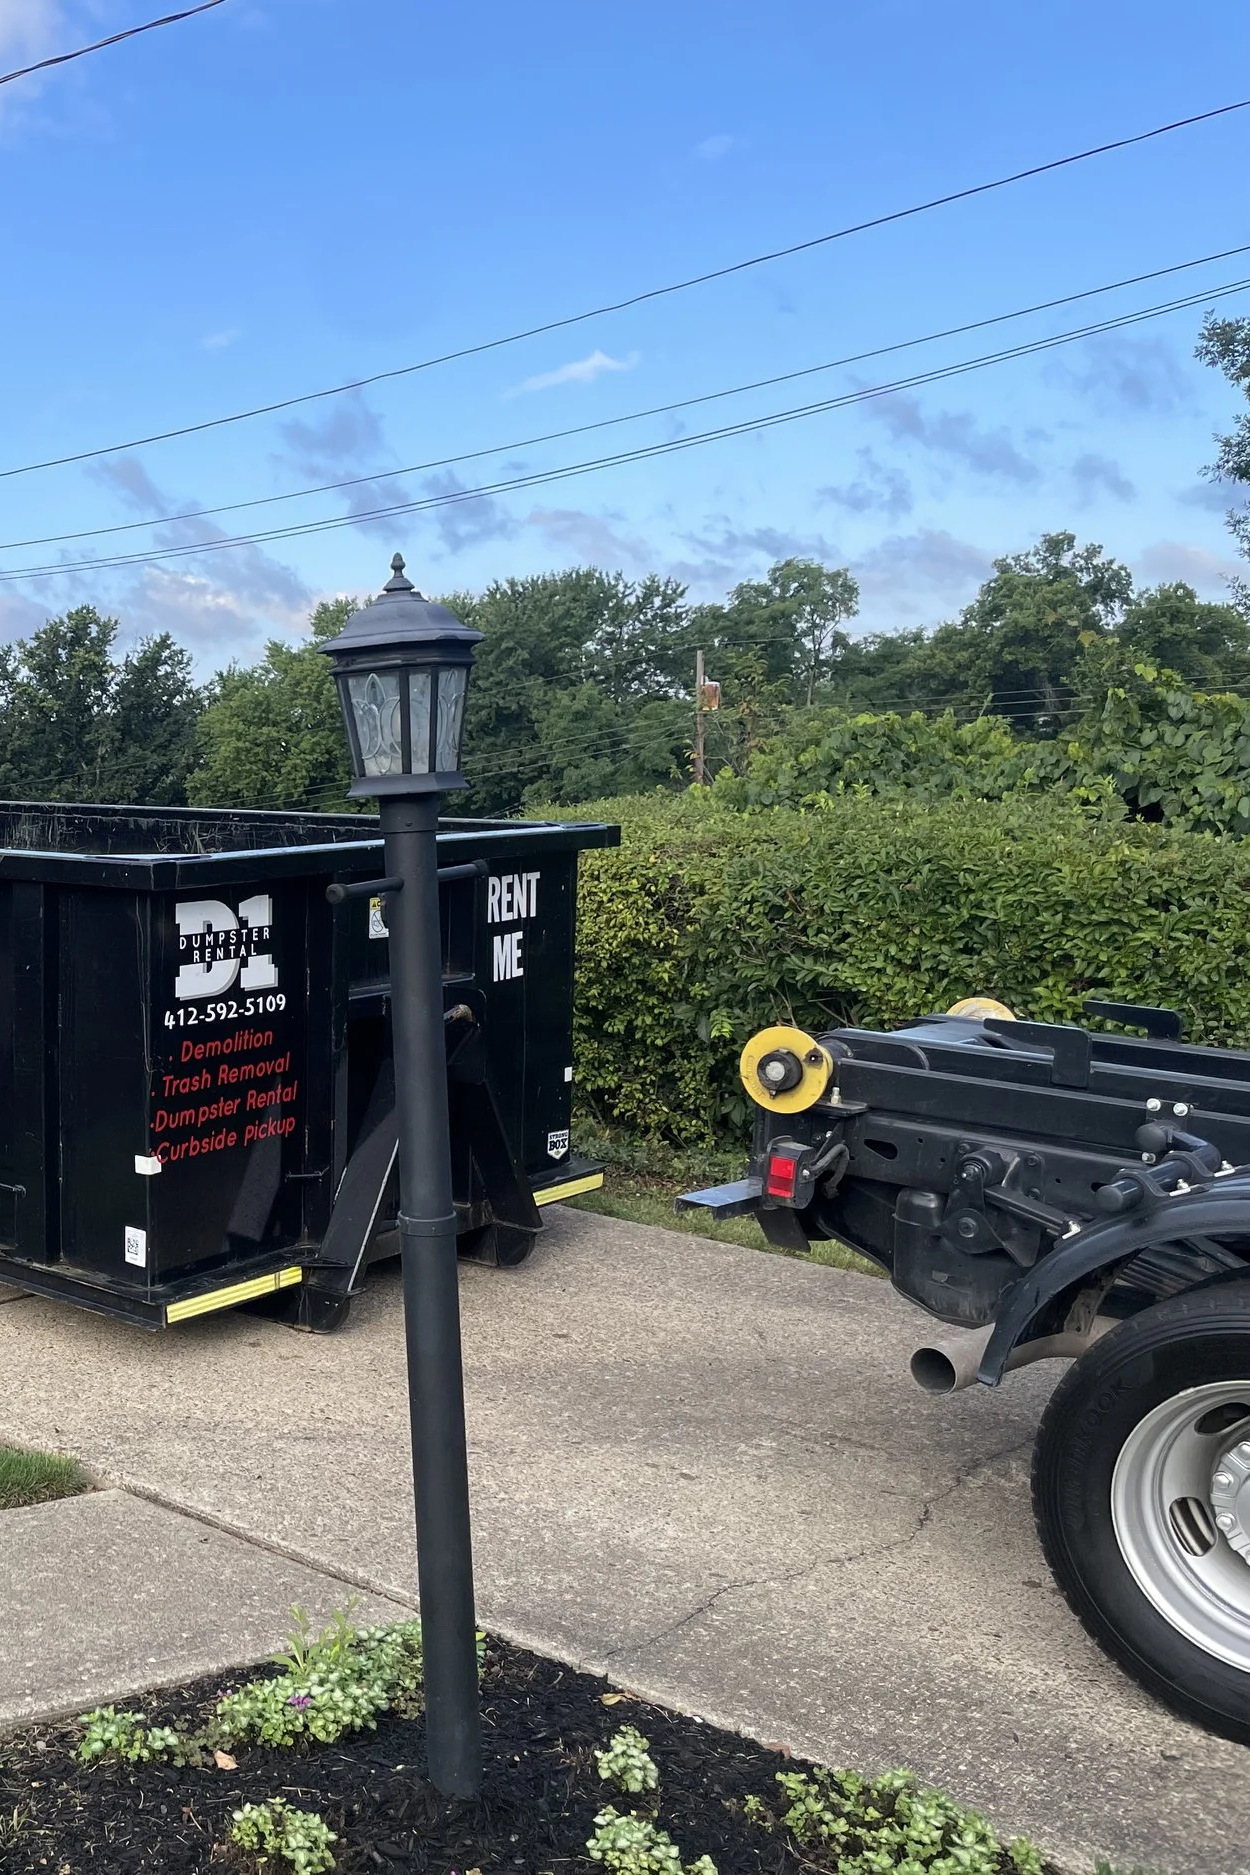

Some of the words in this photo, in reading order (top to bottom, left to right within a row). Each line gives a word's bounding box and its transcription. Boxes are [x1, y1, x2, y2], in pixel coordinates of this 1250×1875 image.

[487, 871, 541, 924] RENT
[179, 927, 270, 950] DUMPSTER
[193, 944, 257, 963] RENTAL
[493, 931, 524, 982] ME
[164, 993, 287, 1030] 412-592-5109
[181, 1028, 273, 1062] Demolition
[162, 1068, 211, 1097] Trash
[217, 1051, 291, 1086] Removal
[155, 1096, 241, 1132] Dumpster
[246, 1080, 298, 1111] Rental
[156, 1127, 237, 1164] Curbside
[549, 1138, 568, 1151] BOX
